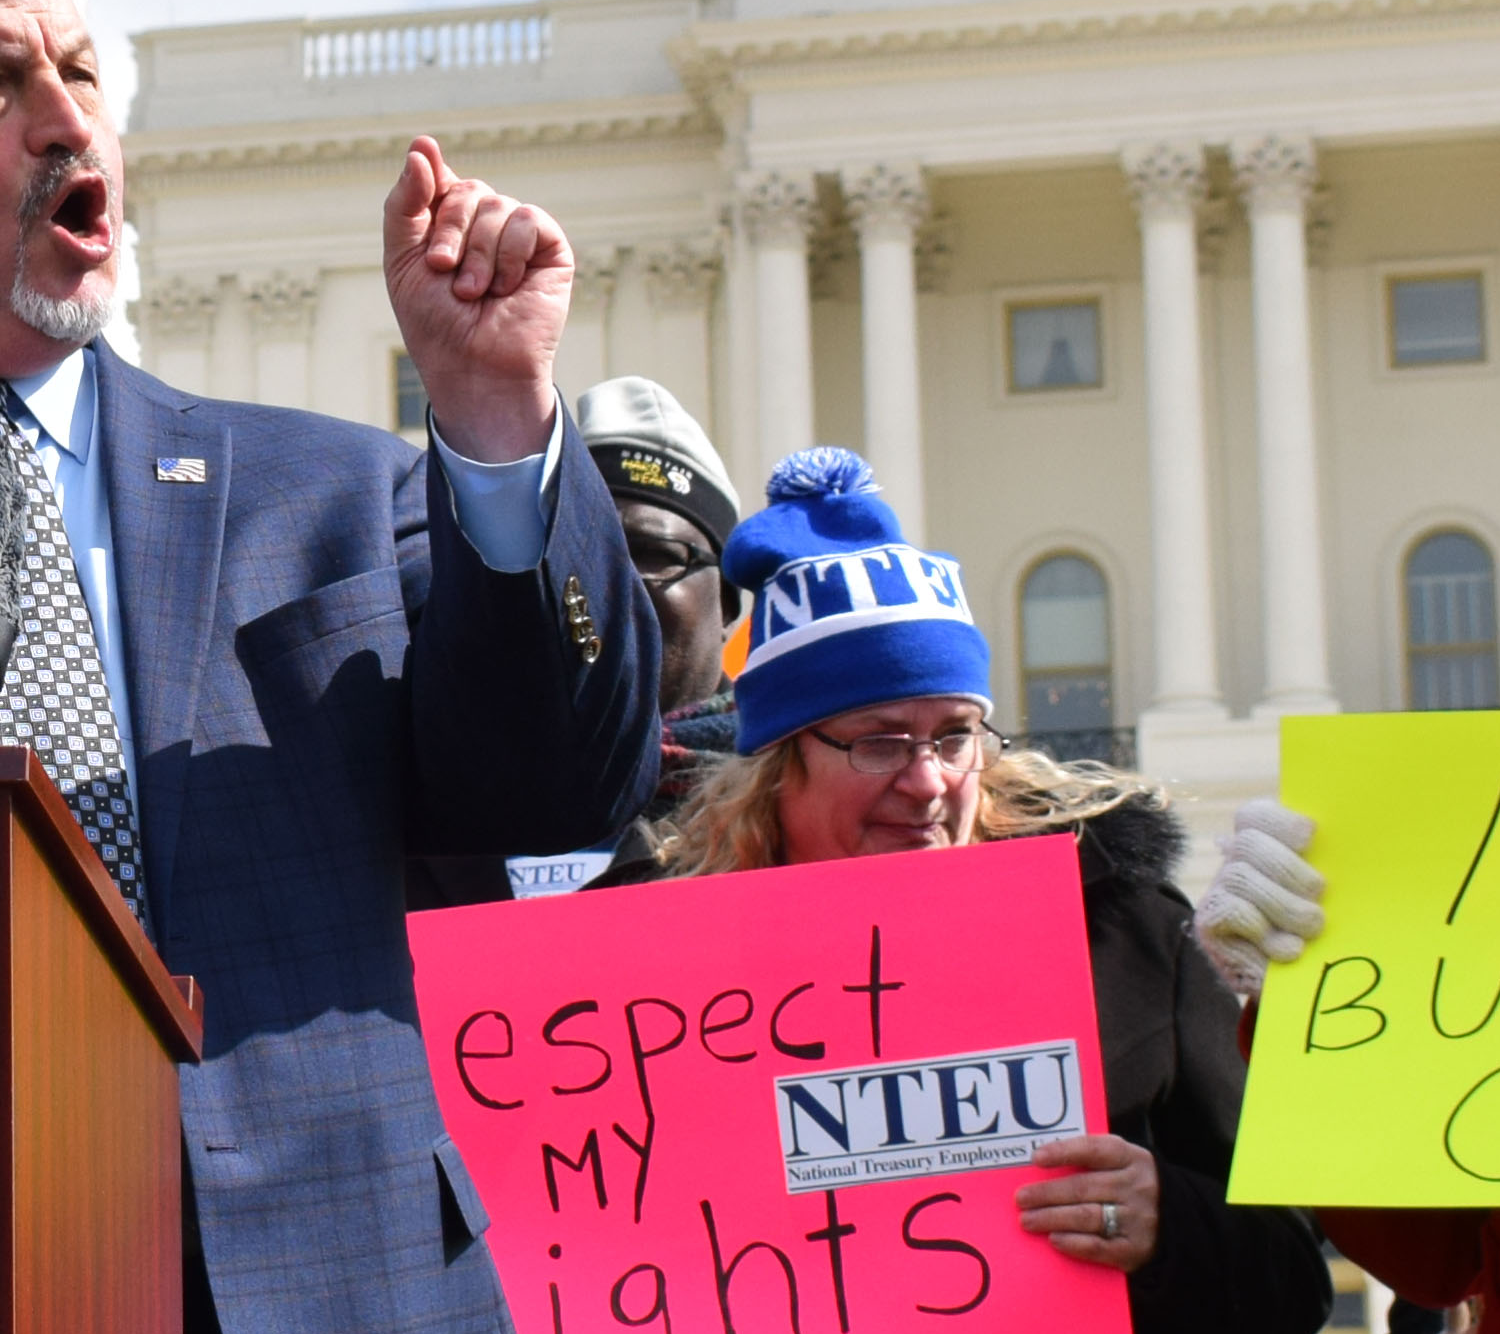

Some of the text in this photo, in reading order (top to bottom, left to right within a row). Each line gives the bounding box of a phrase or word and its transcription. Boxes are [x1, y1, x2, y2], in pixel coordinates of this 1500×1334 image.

[763, 547, 974, 644] NTE
[508, 863, 585, 884] NTEU
[778, 1052, 1072, 1158] NTEU
[542, 1116, 654, 1224] MY
[787, 1157, 858, 1183] National
[860, 1155, 936, 1175] Treasury
[939, 1143, 1027, 1167] Employees
